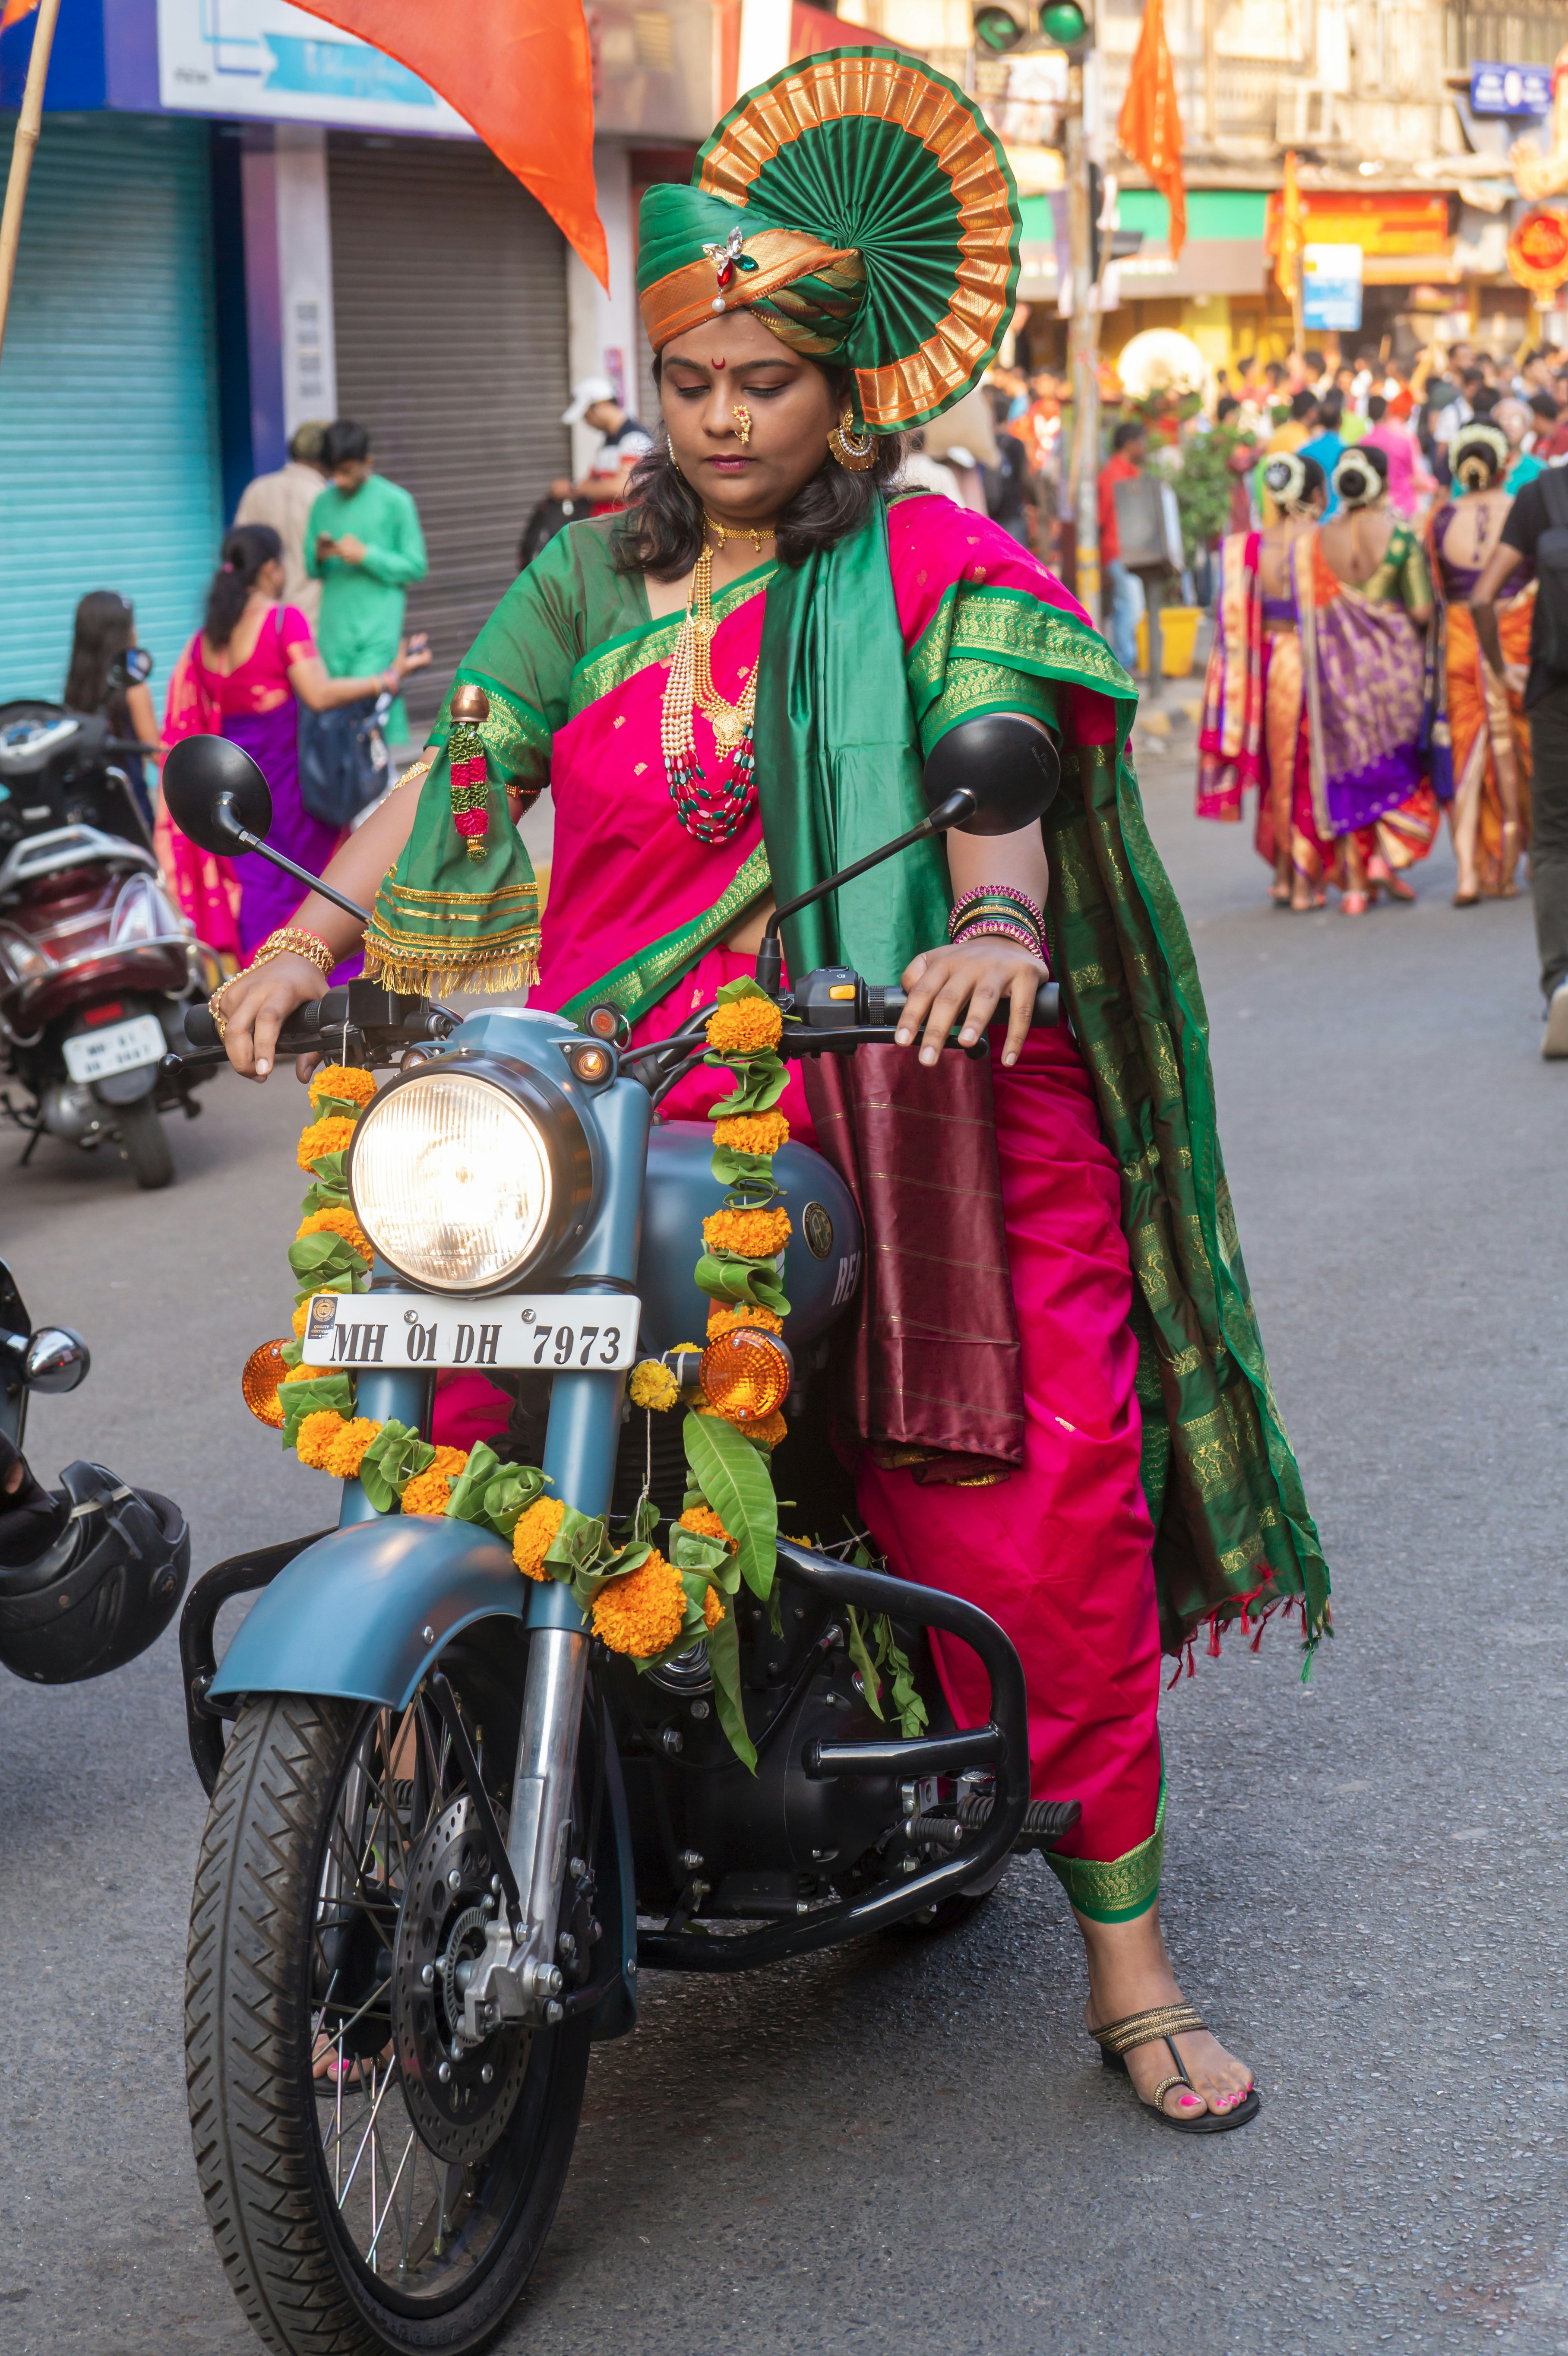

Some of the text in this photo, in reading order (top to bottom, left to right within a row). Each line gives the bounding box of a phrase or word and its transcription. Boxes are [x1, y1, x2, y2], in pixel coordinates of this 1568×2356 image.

[329, 1324, 620, 1366] MH 01 DH 7973
